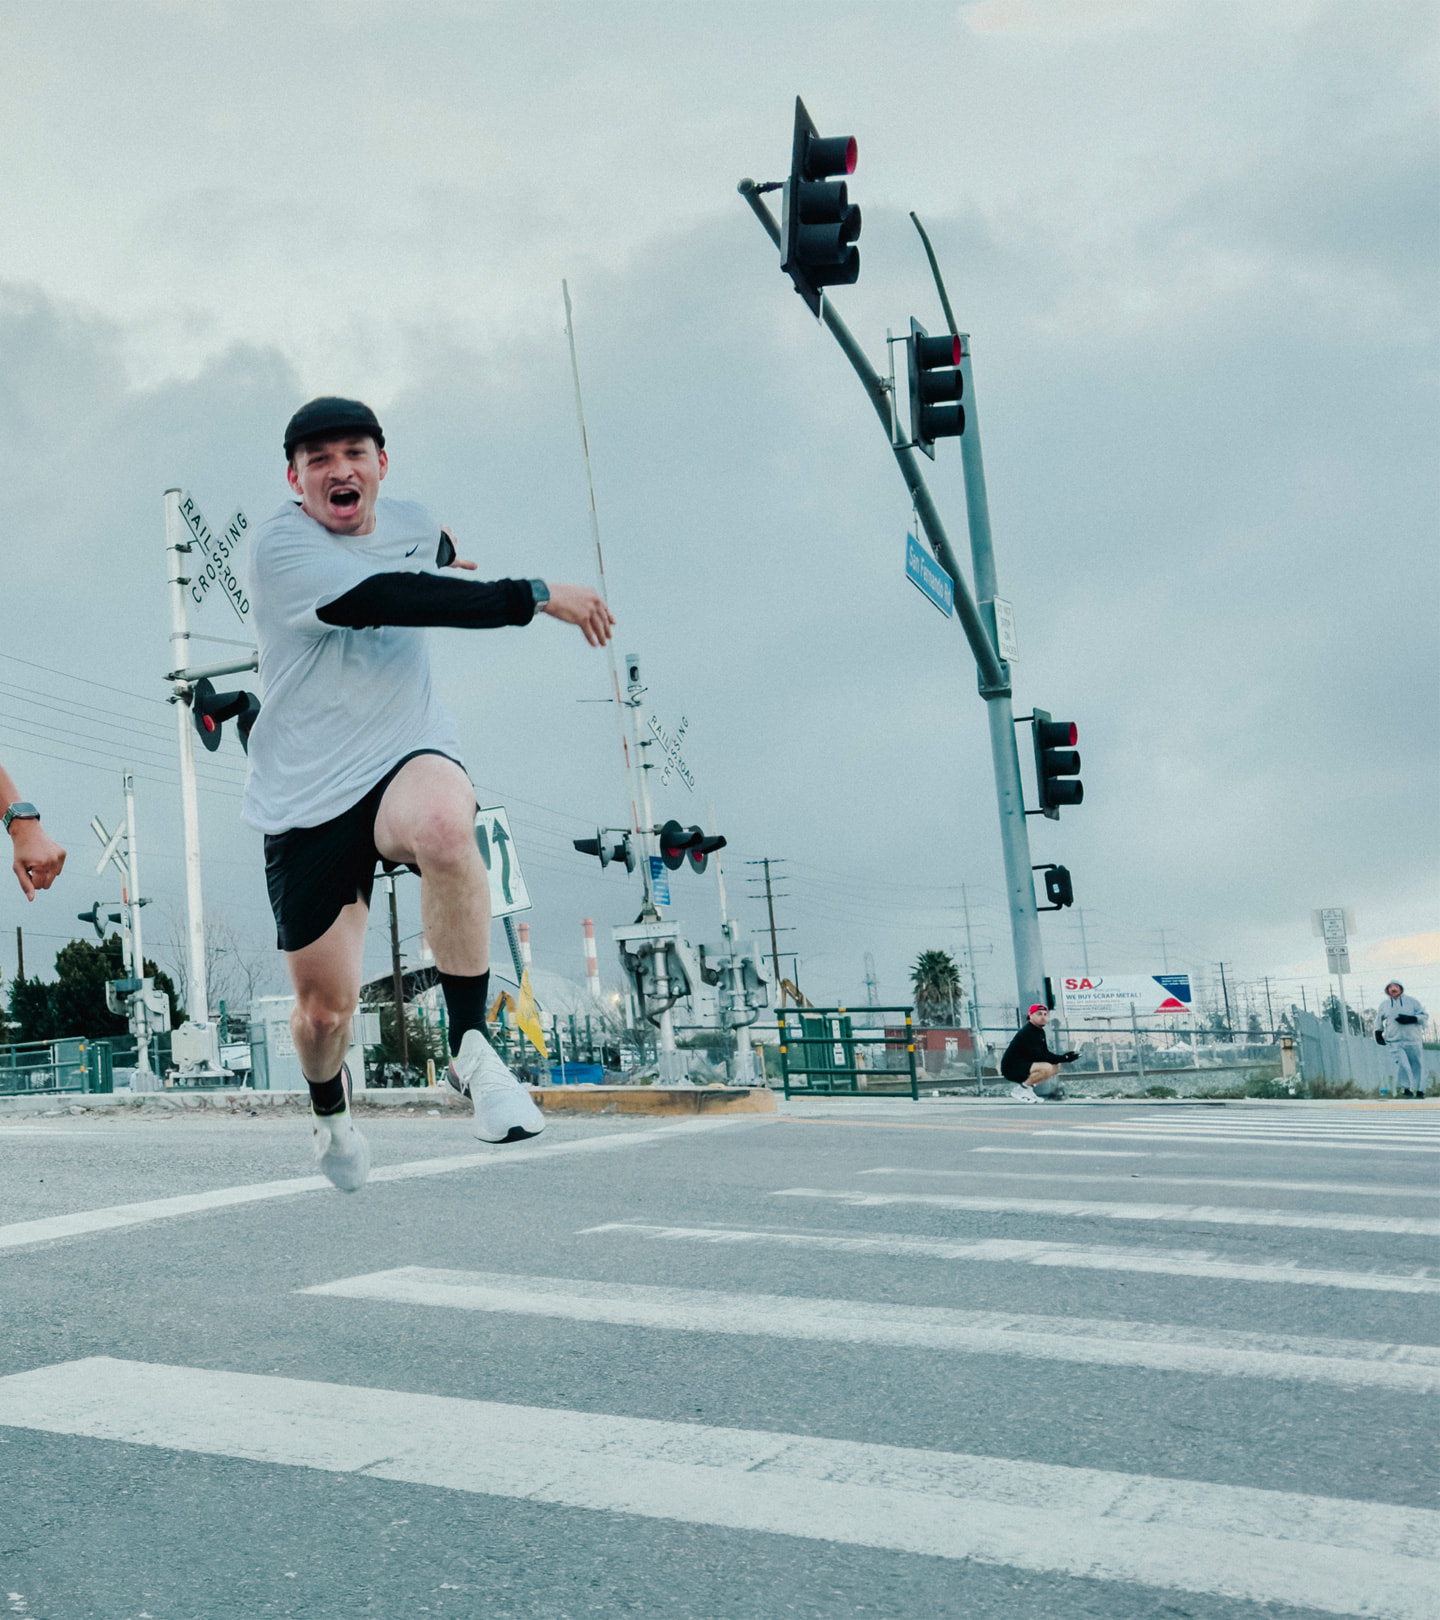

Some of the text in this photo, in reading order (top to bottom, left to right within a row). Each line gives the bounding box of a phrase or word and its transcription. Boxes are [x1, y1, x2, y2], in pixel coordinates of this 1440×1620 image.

[183, 498, 250, 614] RAIL ROAD
[191, 513, 248, 603] CROSSING
[651, 715, 669, 750] RAIL
[661, 716, 689, 787] CROSSING
[1065, 978, 1093, 990] SA
